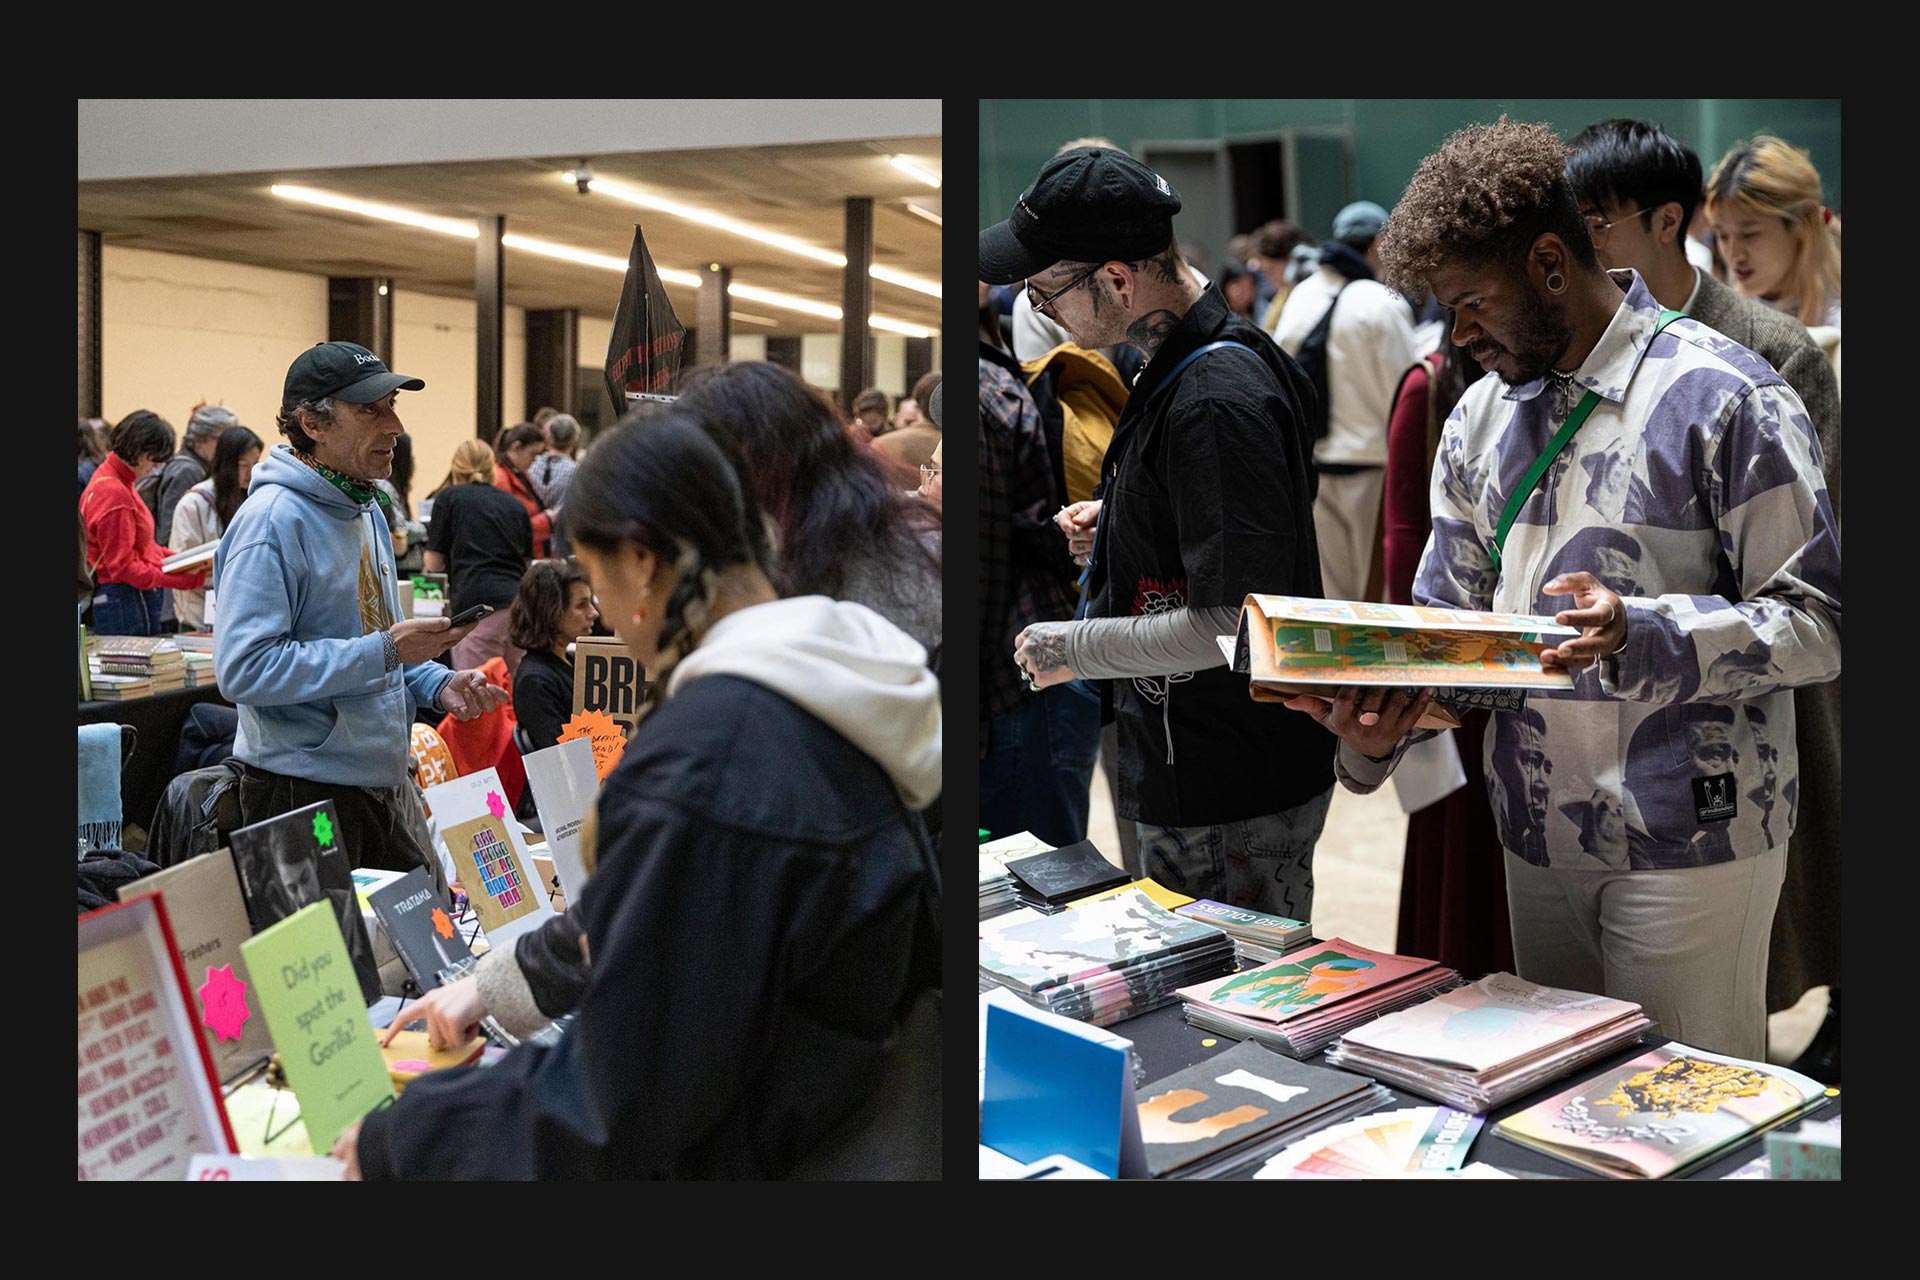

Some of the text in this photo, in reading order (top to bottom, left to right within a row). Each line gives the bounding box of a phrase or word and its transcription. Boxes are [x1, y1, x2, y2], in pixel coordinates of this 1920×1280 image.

[577, 725, 594, 735] THE
[1192, 903, 1256, 922] COLORS
[281, 950, 333, 990] Did you
[296, 986, 346, 1034] spot the
[310, 1018, 357, 1066] Gorilla?
